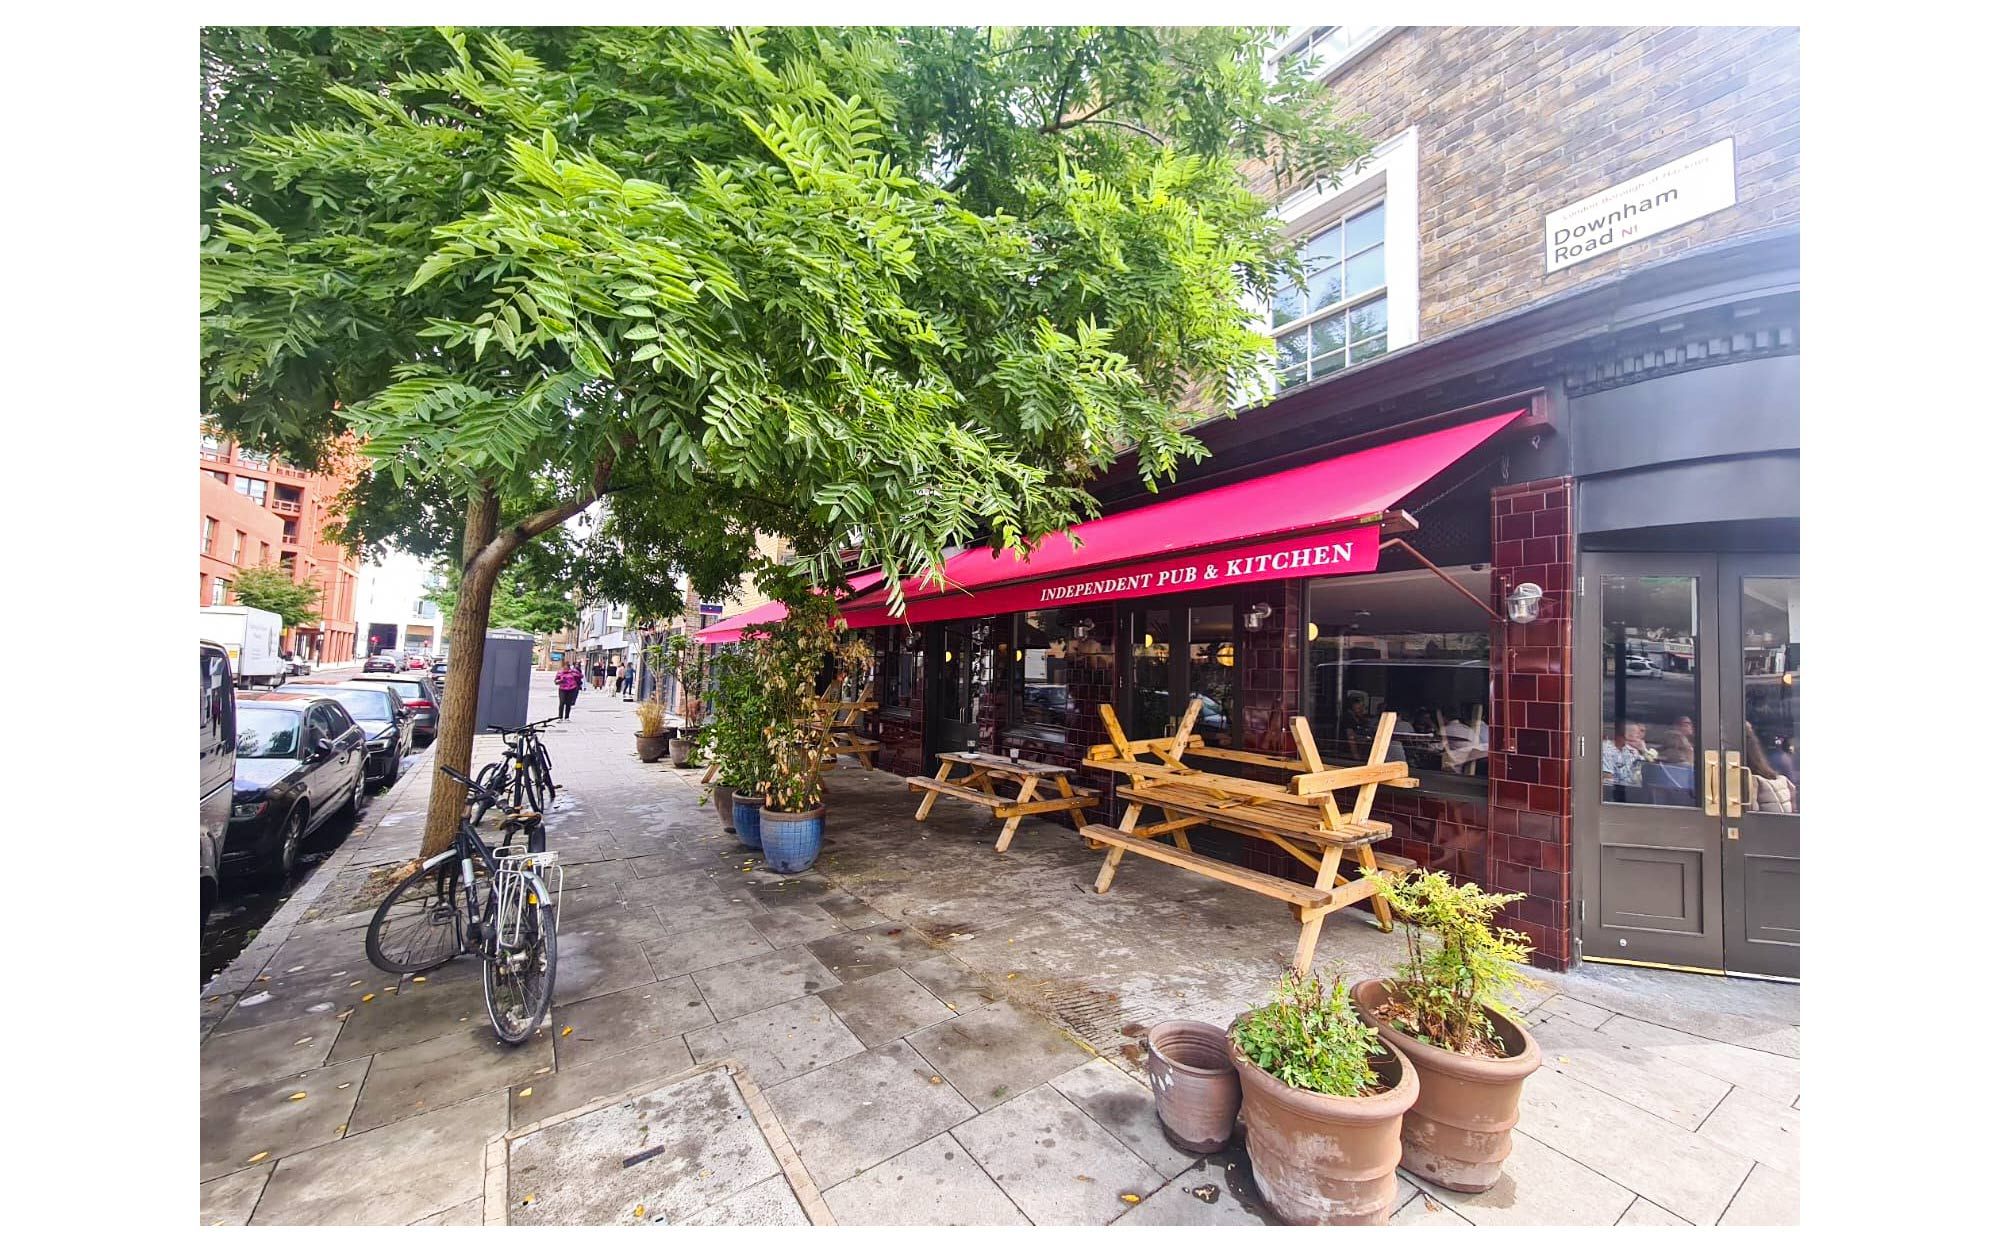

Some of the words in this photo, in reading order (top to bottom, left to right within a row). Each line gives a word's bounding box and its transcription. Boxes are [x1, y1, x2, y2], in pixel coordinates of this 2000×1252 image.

[1553, 188, 1678, 246] Downham
[1554, 228, 1613, 263] Road
[1040, 573, 1153, 602] INDEPENDENT
[1158, 566, 1197, 587] PUB
[1203, 565, 1219, 581] &
[1226, 542, 1354, 578] KITCHEN
